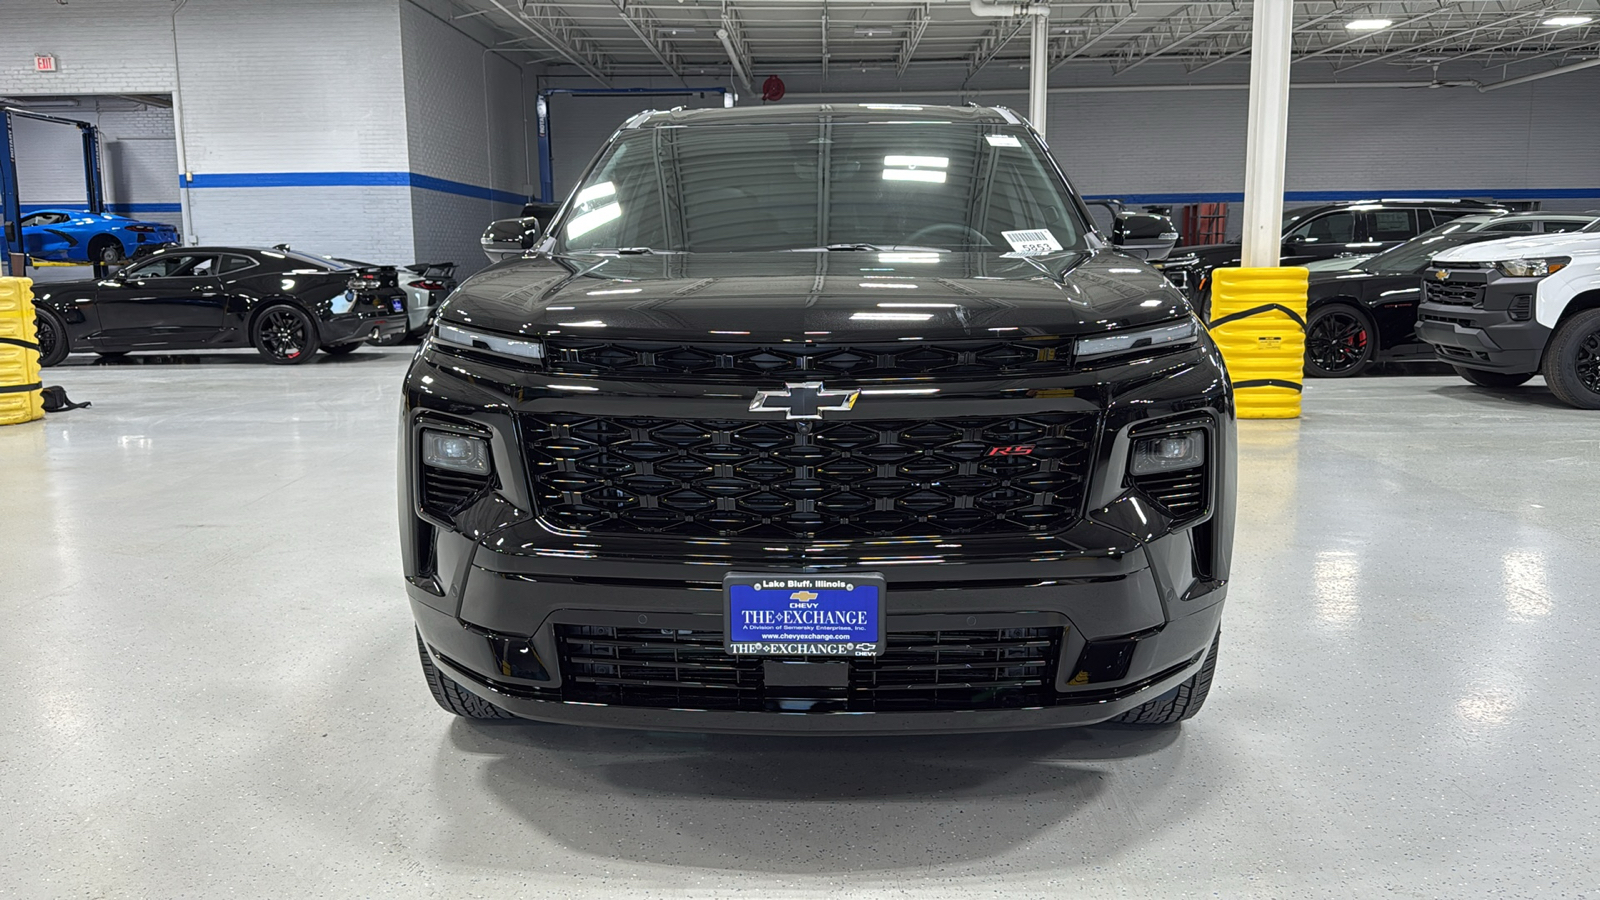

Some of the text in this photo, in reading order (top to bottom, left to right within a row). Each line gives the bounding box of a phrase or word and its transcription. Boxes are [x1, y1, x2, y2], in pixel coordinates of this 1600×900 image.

[37, 57, 51, 69] EXIT
[1022, 243, 1052, 252] 5853
[988, 446, 1033, 456] RS
[788, 581, 812, 589] Bluff,
[742, 611, 867, 624] THE EXCHANGE
[762, 633, 850, 641] www.chevyexchange.com
[730, 644, 847, 654] THE EXCHANGE
